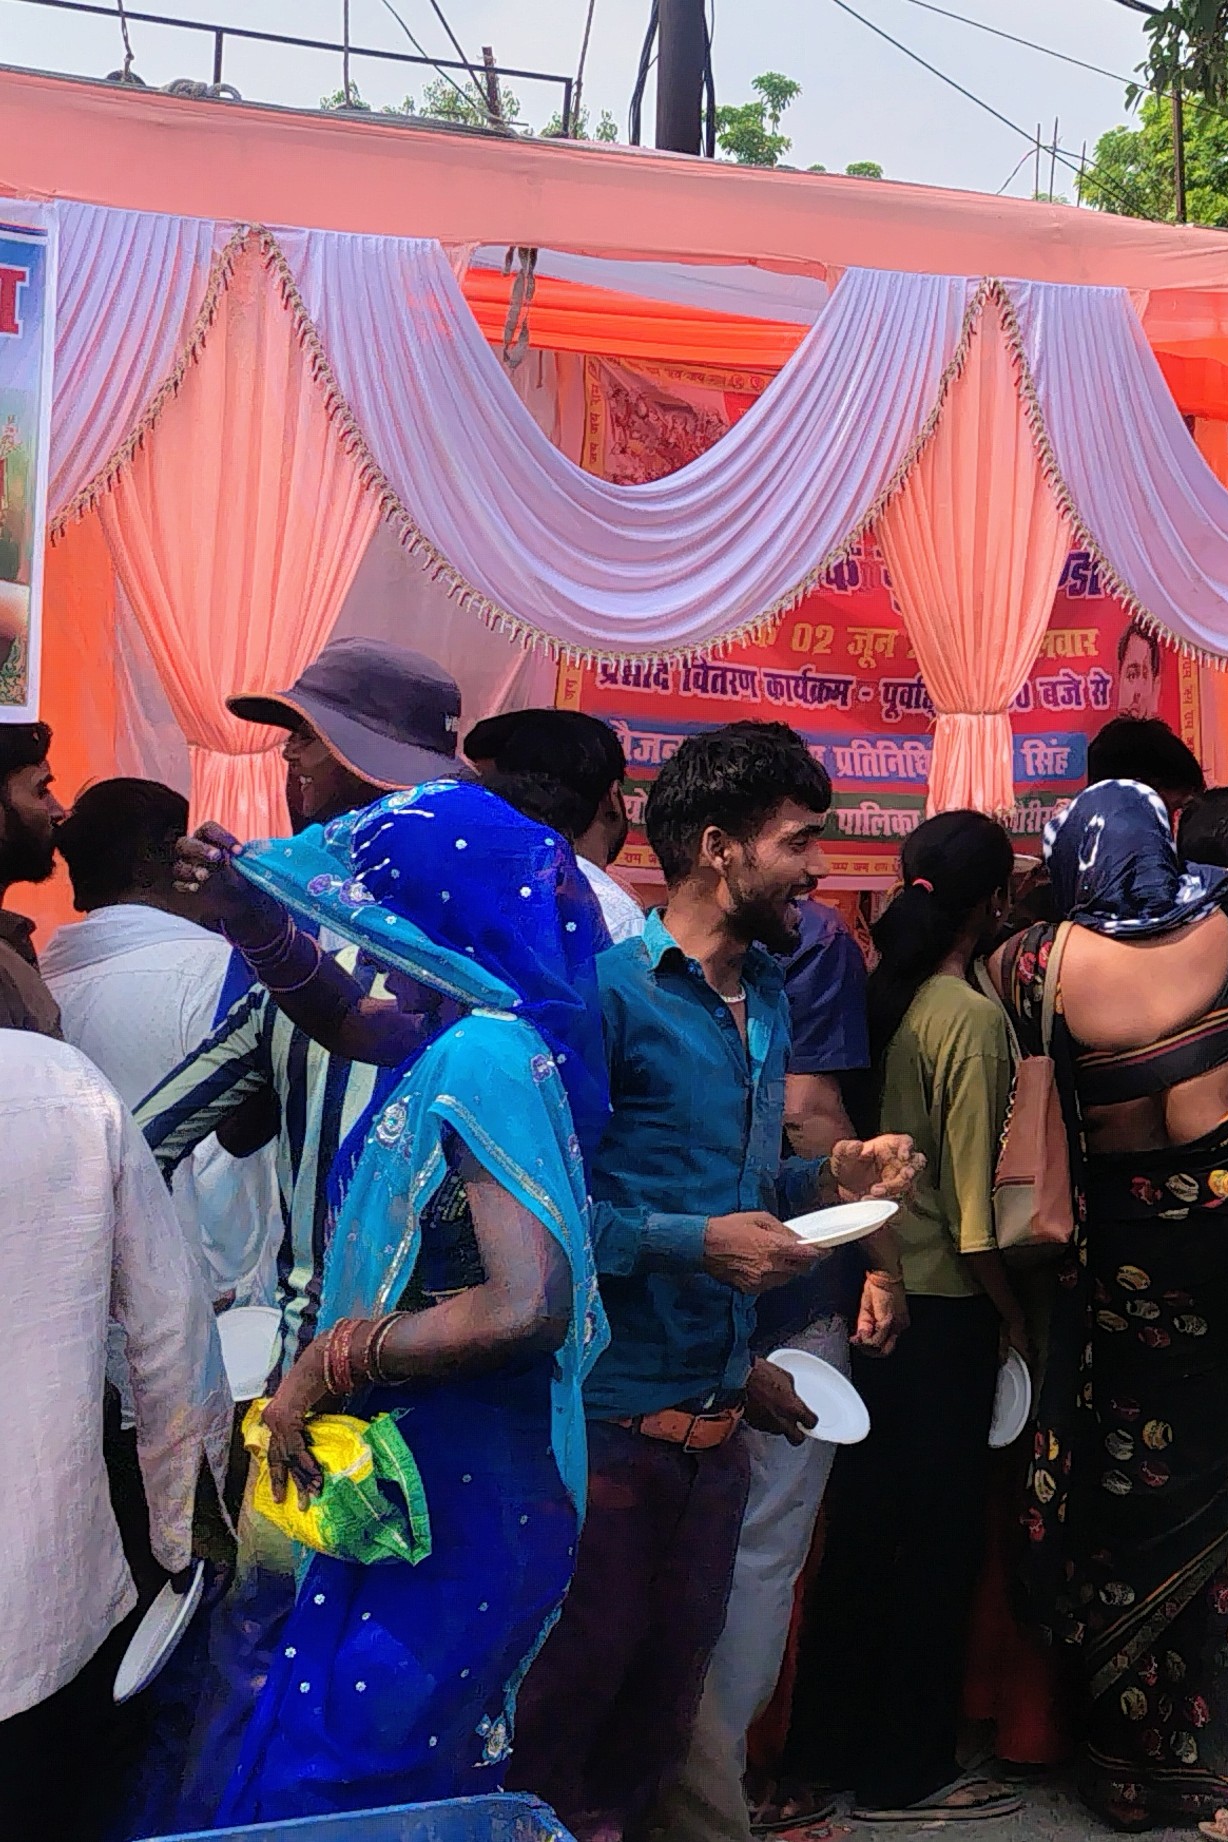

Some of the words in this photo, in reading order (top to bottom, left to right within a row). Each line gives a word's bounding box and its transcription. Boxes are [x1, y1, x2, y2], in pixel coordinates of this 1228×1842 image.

[791, 622, 834, 655] 02
[846, 627, 899, 669] जून
[681, 656, 758, 699] वितरण
[763, 660, 853, 706] कार्यक्रम
[1037, 671, 1083, 707] बजे
[1089, 670, 1111, 707] से
[1022, 738, 1072, 777] सिंह
[838, 802, 921, 838] पालिका
